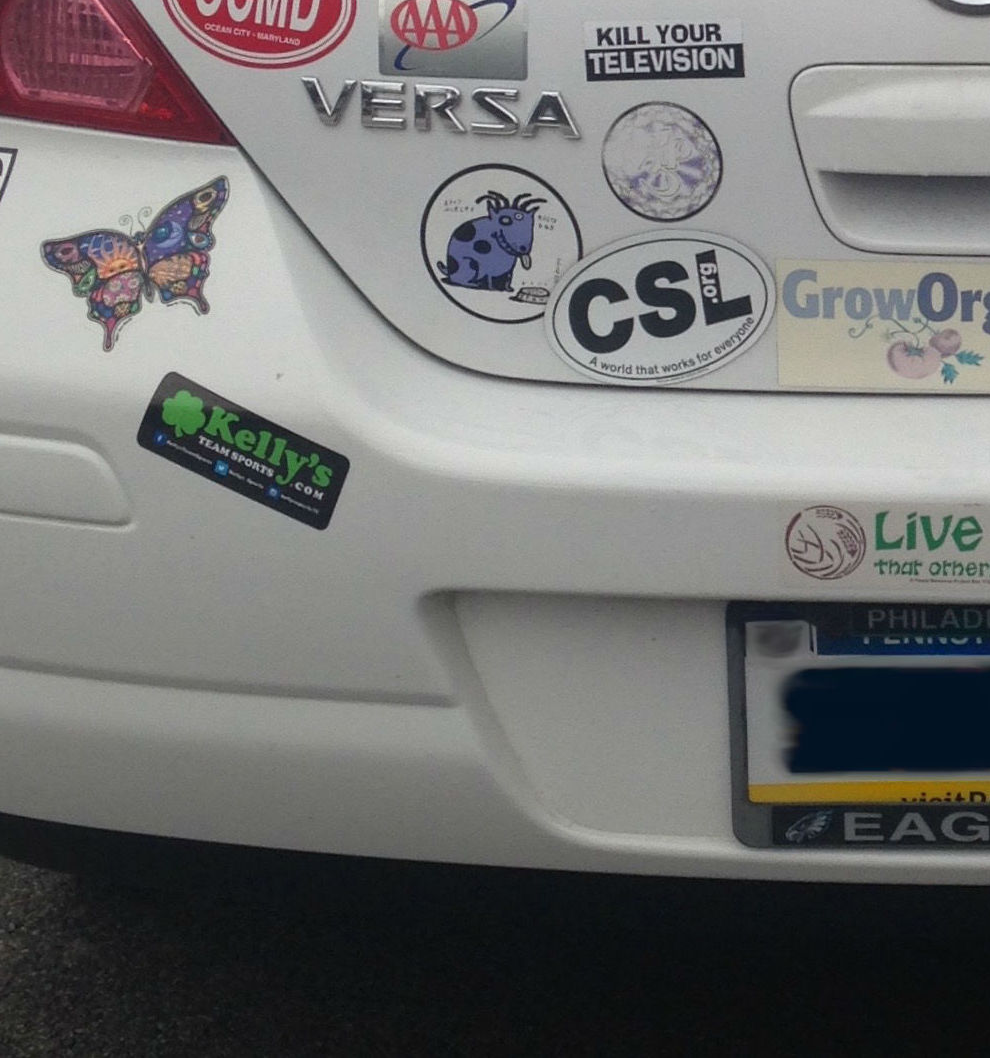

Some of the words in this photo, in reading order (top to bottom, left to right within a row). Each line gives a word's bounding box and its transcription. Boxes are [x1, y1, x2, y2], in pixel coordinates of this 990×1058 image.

[204, 22, 232, 35] OCEAN
[233, 28, 251, 38] CITY
[257, 31, 302, 47] MARYLAND
[597, 25, 650, 47] KILL
[657, 23, 722, 44] YOUR
[588, 47, 736, 76] TELEVISION
[301, 76, 582, 140] VERSA
[568, 249, 753, 355] CSL
[700, 262, 718, 304] .org
[588, 356, 598, 368] A
[601, 361, 633, 375] world
[635, 365, 660, 376] that
[661, 357, 696, 374] works
[696, 350, 714, 365] for
[713, 316, 755, 356] everyone
[198, 434, 231, 458] TEAM
[230, 450, 275, 478] SPORTS
[203, 406, 333, 487] Kelly's
[874, 510, 984, 553] Live
[874, 558, 922, 577] that
